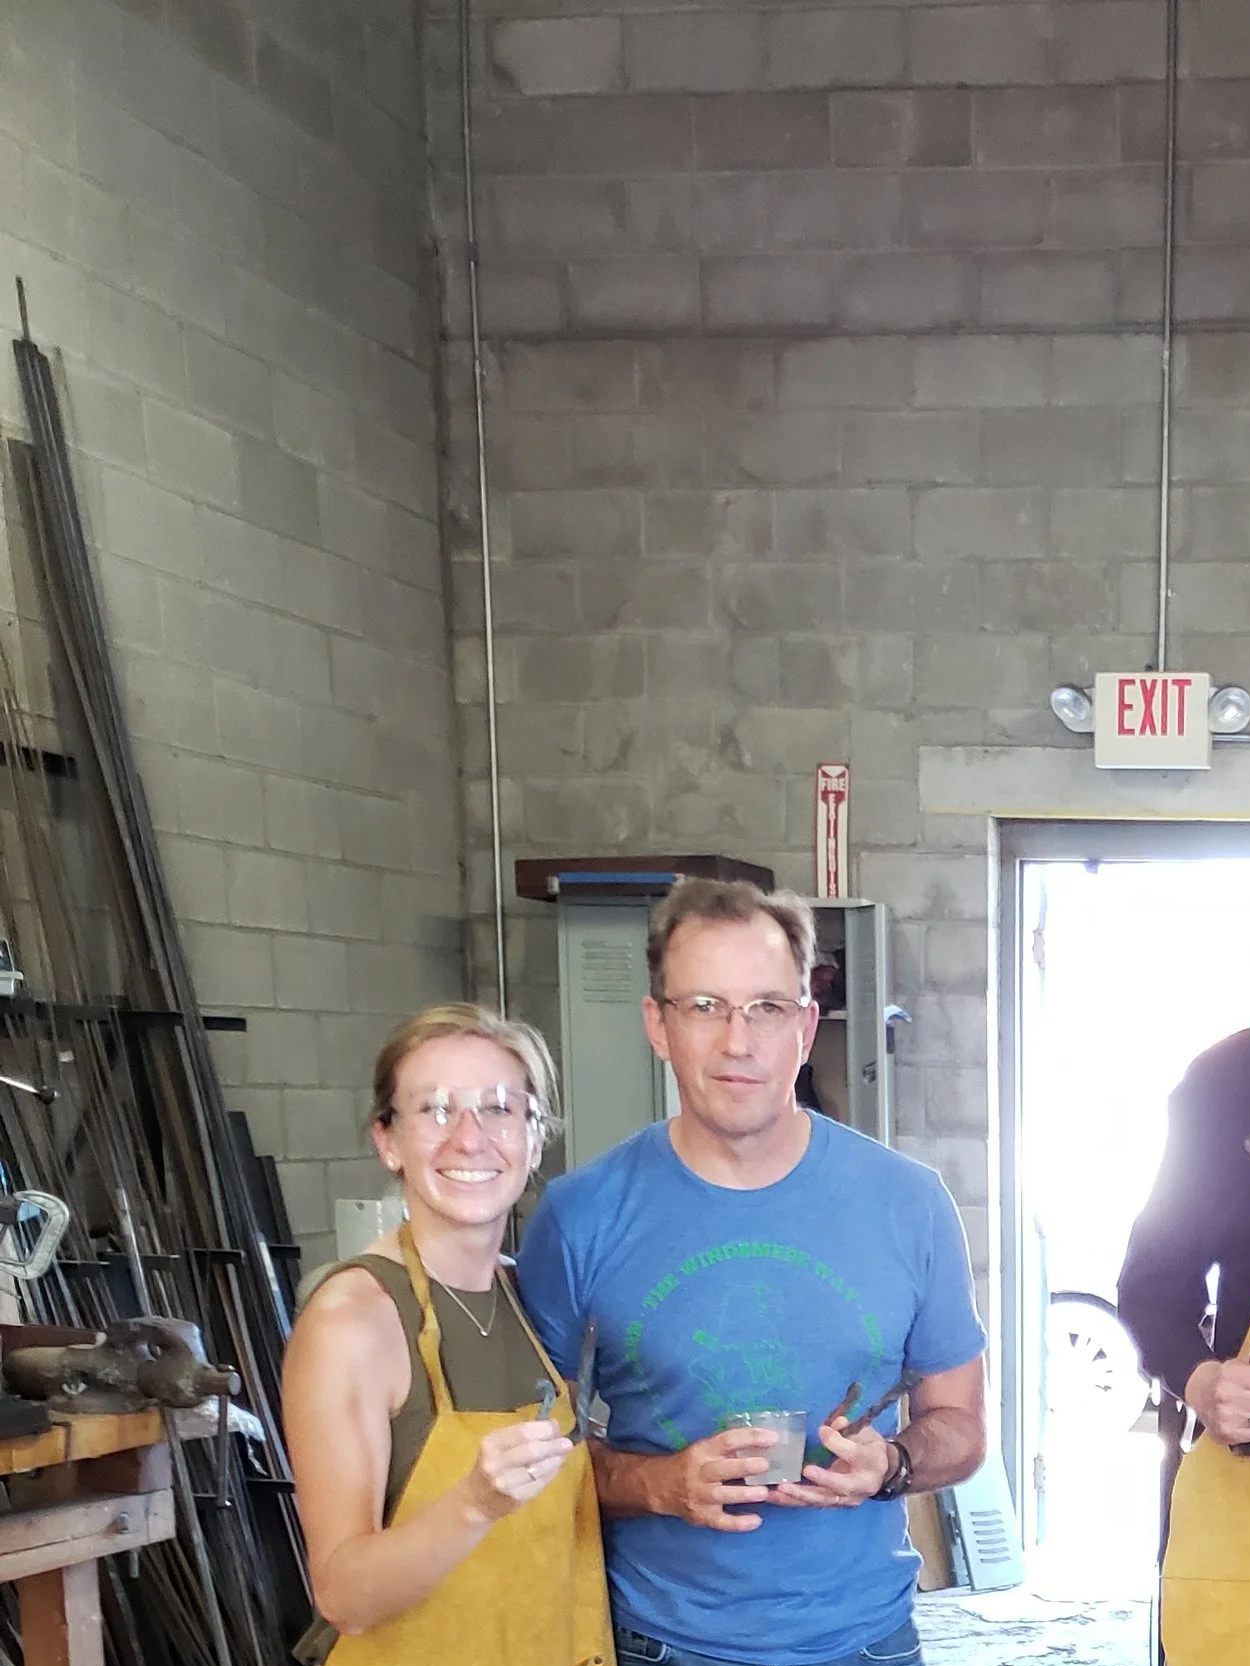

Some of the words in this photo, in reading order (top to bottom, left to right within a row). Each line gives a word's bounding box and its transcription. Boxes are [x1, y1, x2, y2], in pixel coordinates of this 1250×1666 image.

[1117, 678, 1192, 737] EXIT
[820, 778, 846, 791] FIRE
[828, 792, 837, 899] EXTINGUIS
